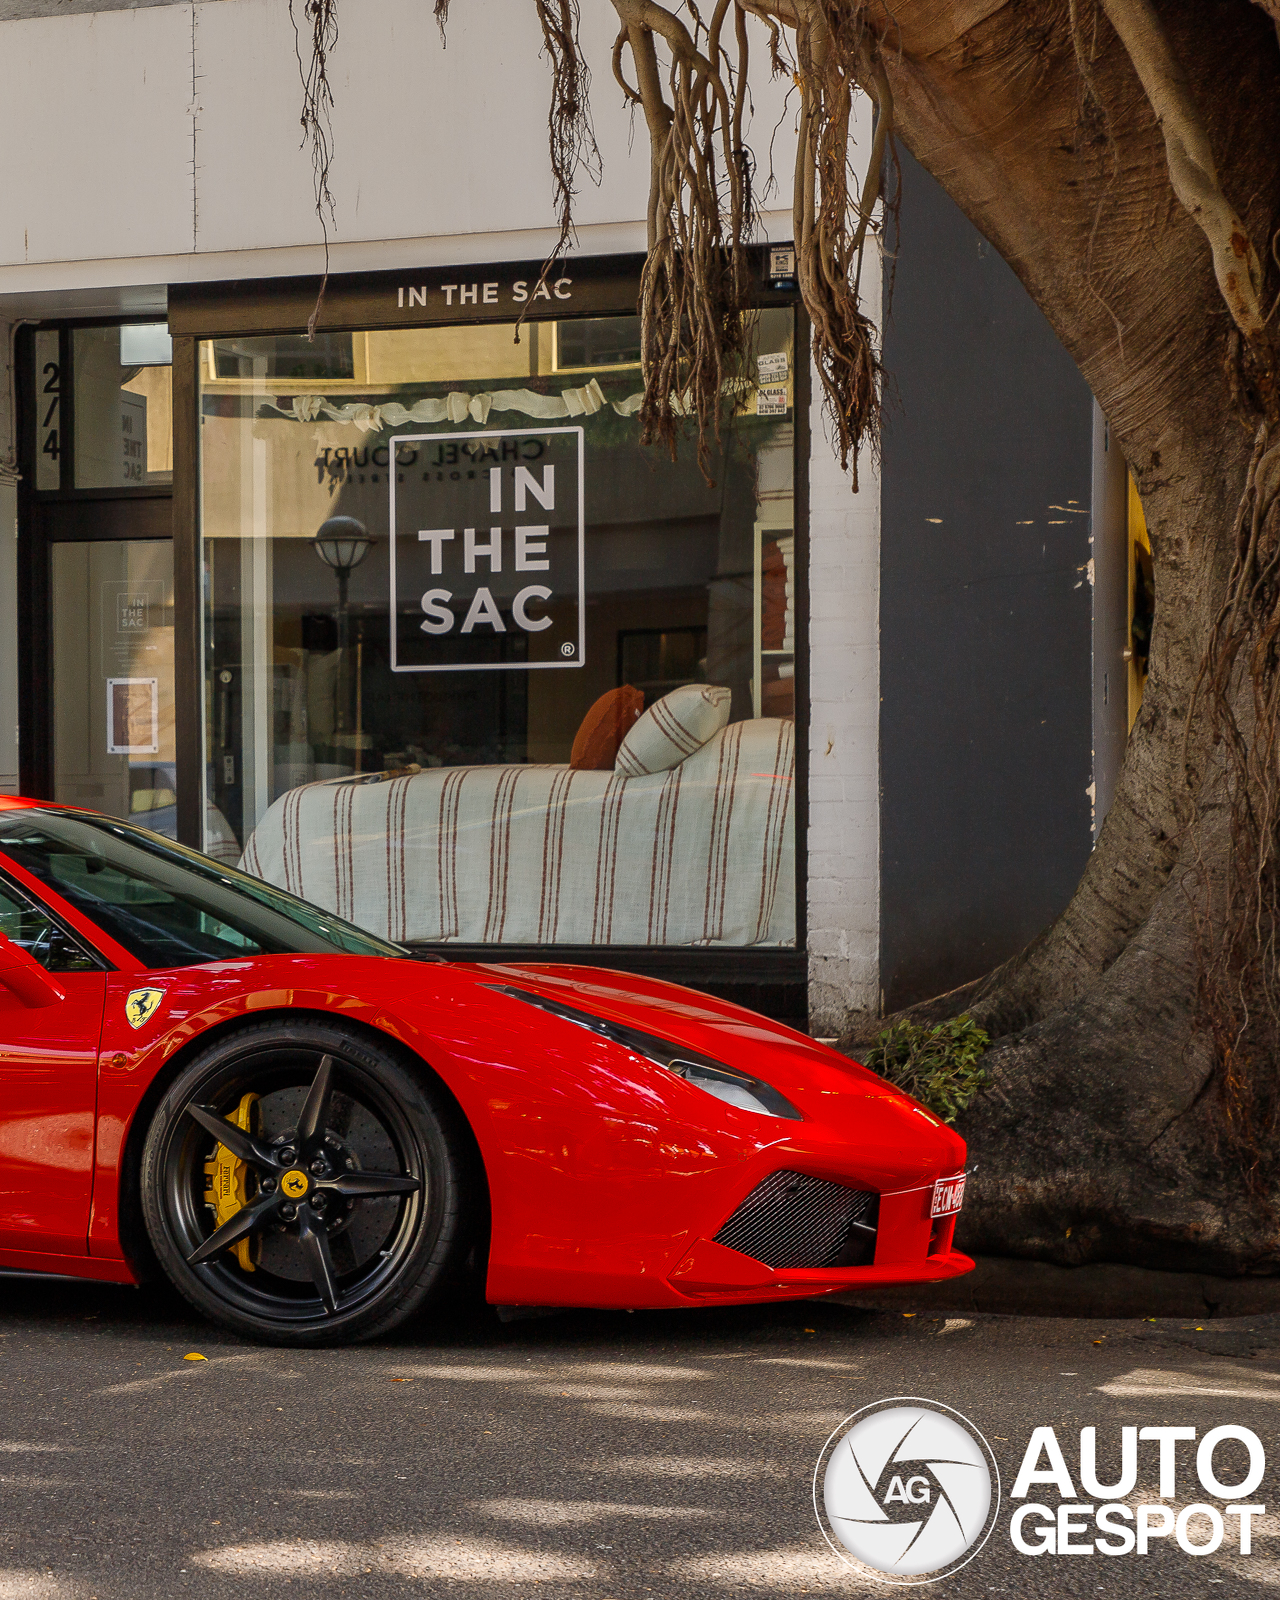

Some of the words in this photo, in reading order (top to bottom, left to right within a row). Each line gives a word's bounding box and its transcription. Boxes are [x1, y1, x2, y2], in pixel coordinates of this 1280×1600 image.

[397, 286, 427, 308] IN
[441, 282, 499, 306] THE
[512, 278, 572, 302] SAC
[489, 464, 555, 513] IN
[418, 525, 550, 575] THE
[420, 585, 554, 635] SAC
